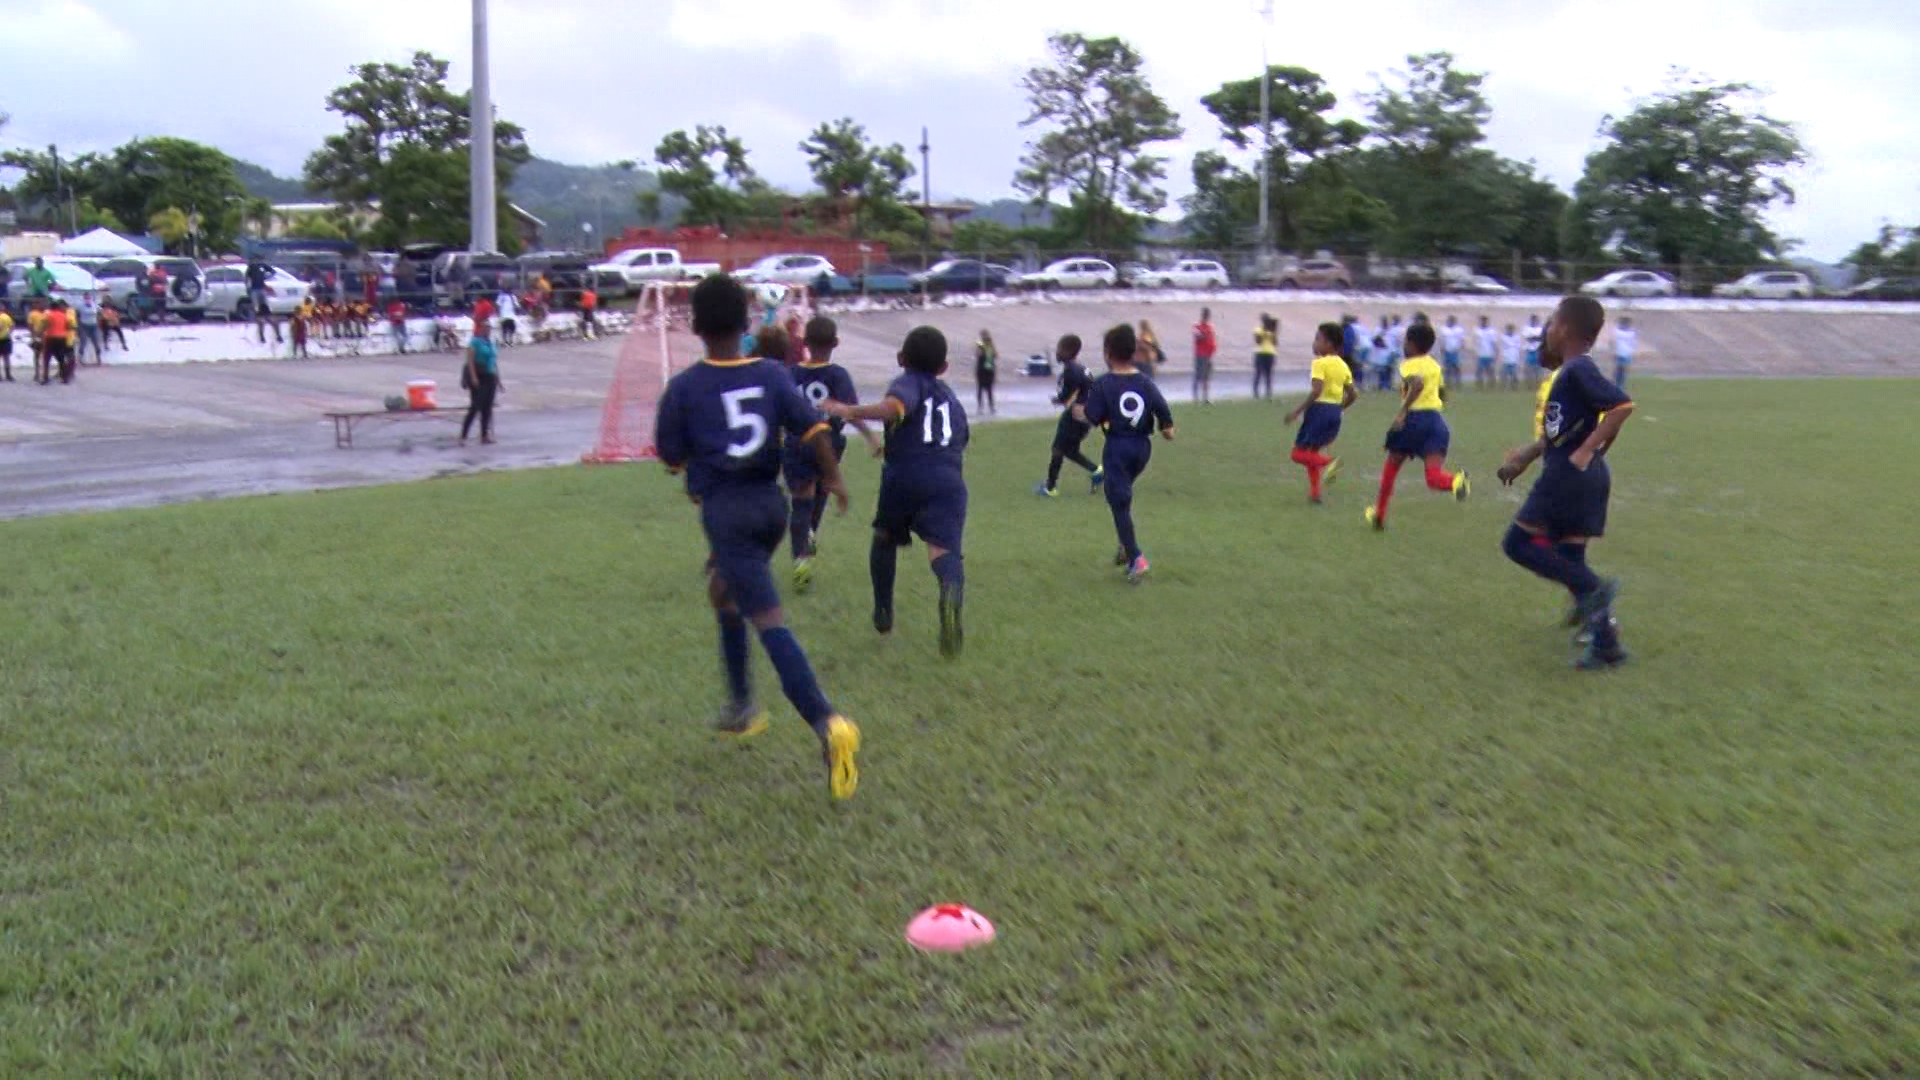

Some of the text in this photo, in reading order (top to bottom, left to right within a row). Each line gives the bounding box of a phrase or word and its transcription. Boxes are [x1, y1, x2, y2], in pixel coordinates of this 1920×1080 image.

[721, 386, 767, 457] 5
[923, 397, 952, 446] 11
[1119, 390, 1145, 428] 9
